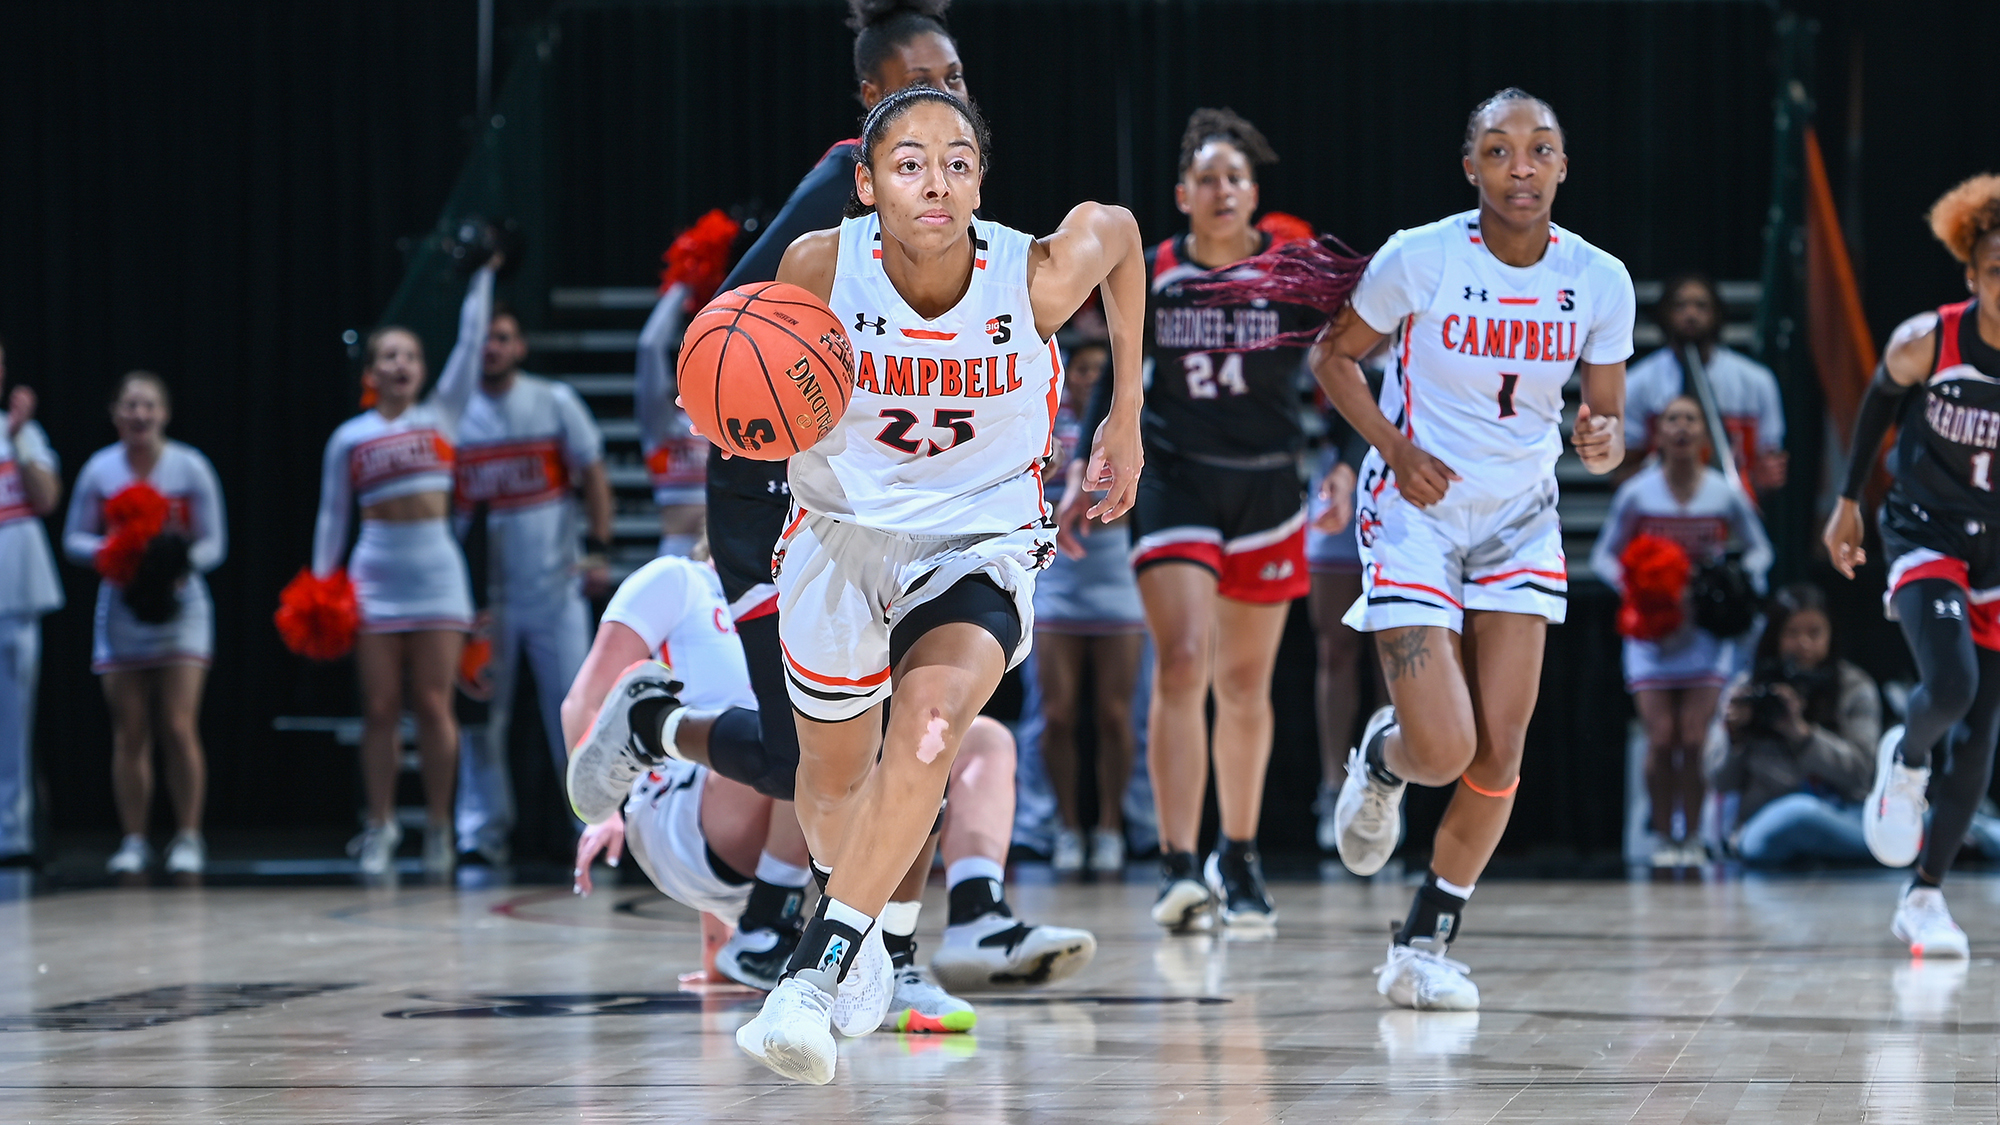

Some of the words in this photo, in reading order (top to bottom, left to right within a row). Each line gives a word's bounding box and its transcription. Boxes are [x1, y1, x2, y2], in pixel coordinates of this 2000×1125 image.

[1442, 314, 1577, 362] CAMPBELL
[856, 350, 1023, 398] AMPBELL
[1183, 352, 1249, 399] 24
[1498, 372, 1520, 420] 1
[784, 355, 835, 444] PALDING
[1925, 391, 2000, 449] GARDNER
[875, 408, 976, 457] 25
[1970, 450, 1994, 492] 1
